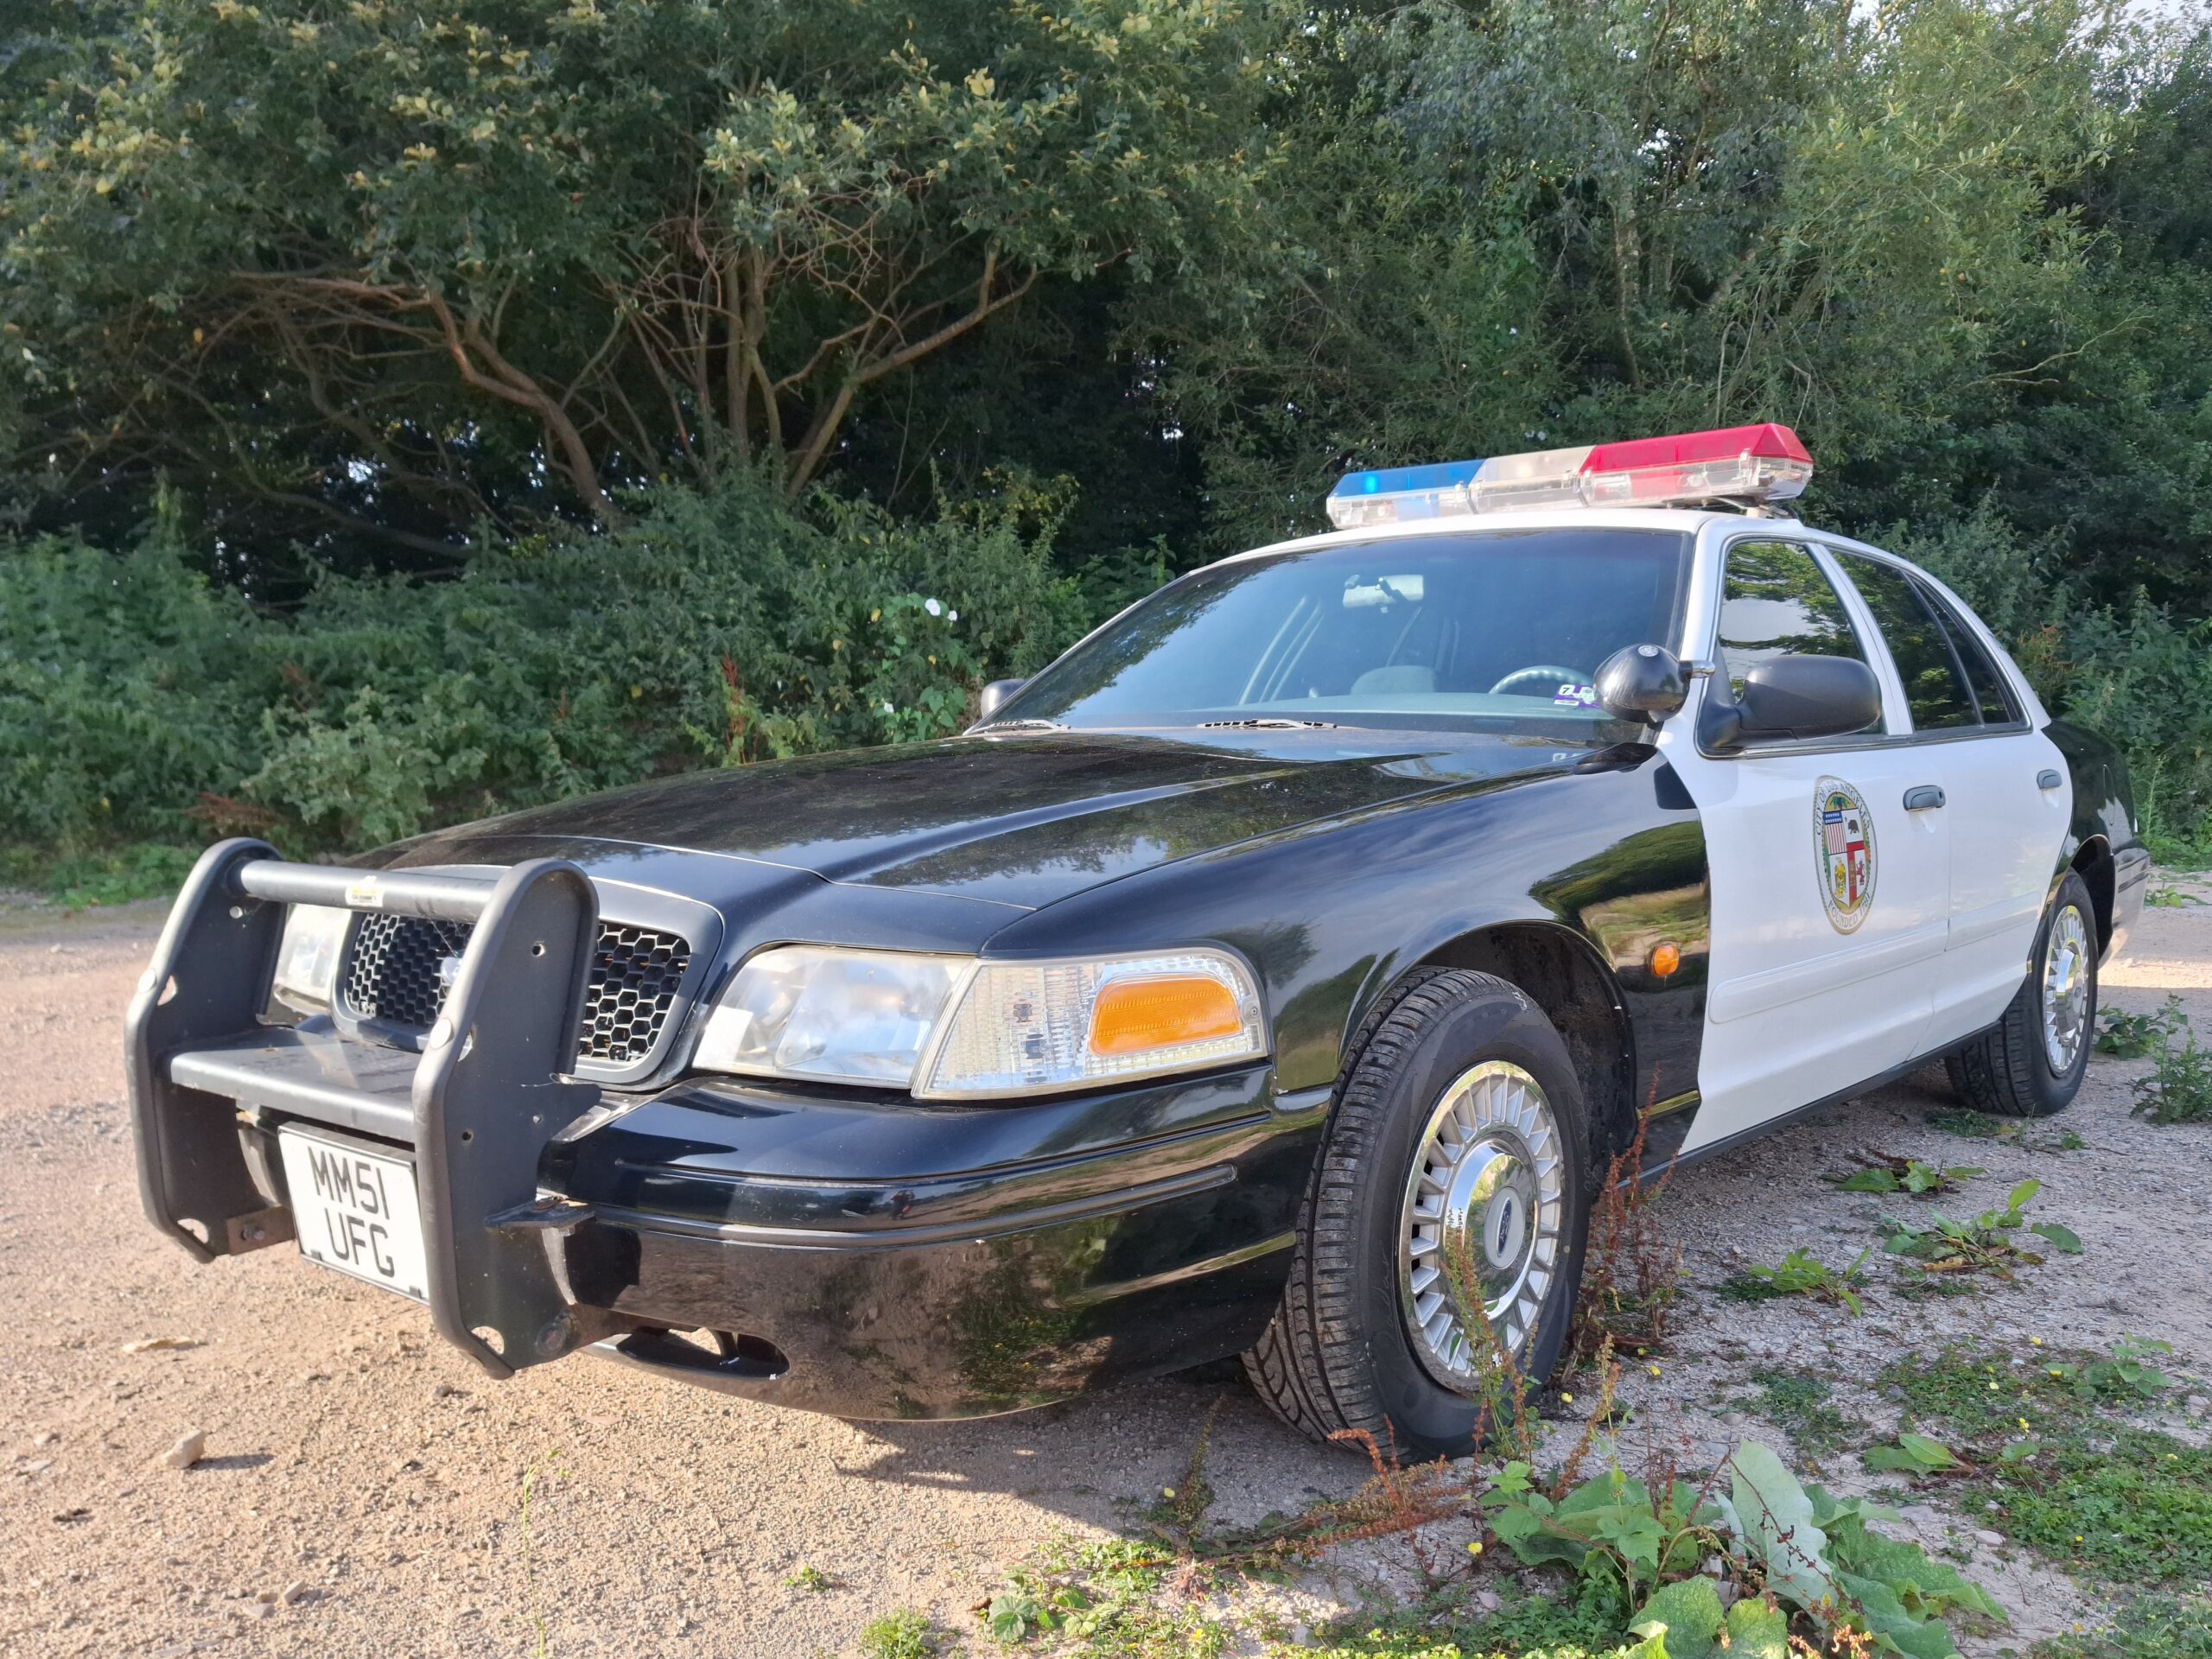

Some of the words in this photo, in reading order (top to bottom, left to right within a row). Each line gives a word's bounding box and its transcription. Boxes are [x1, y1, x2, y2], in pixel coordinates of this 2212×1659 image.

[1827, 899, 1859, 928] FOUNDED
[308, 1146, 391, 1220] MM51
[324, 1207, 395, 1278] UFG
